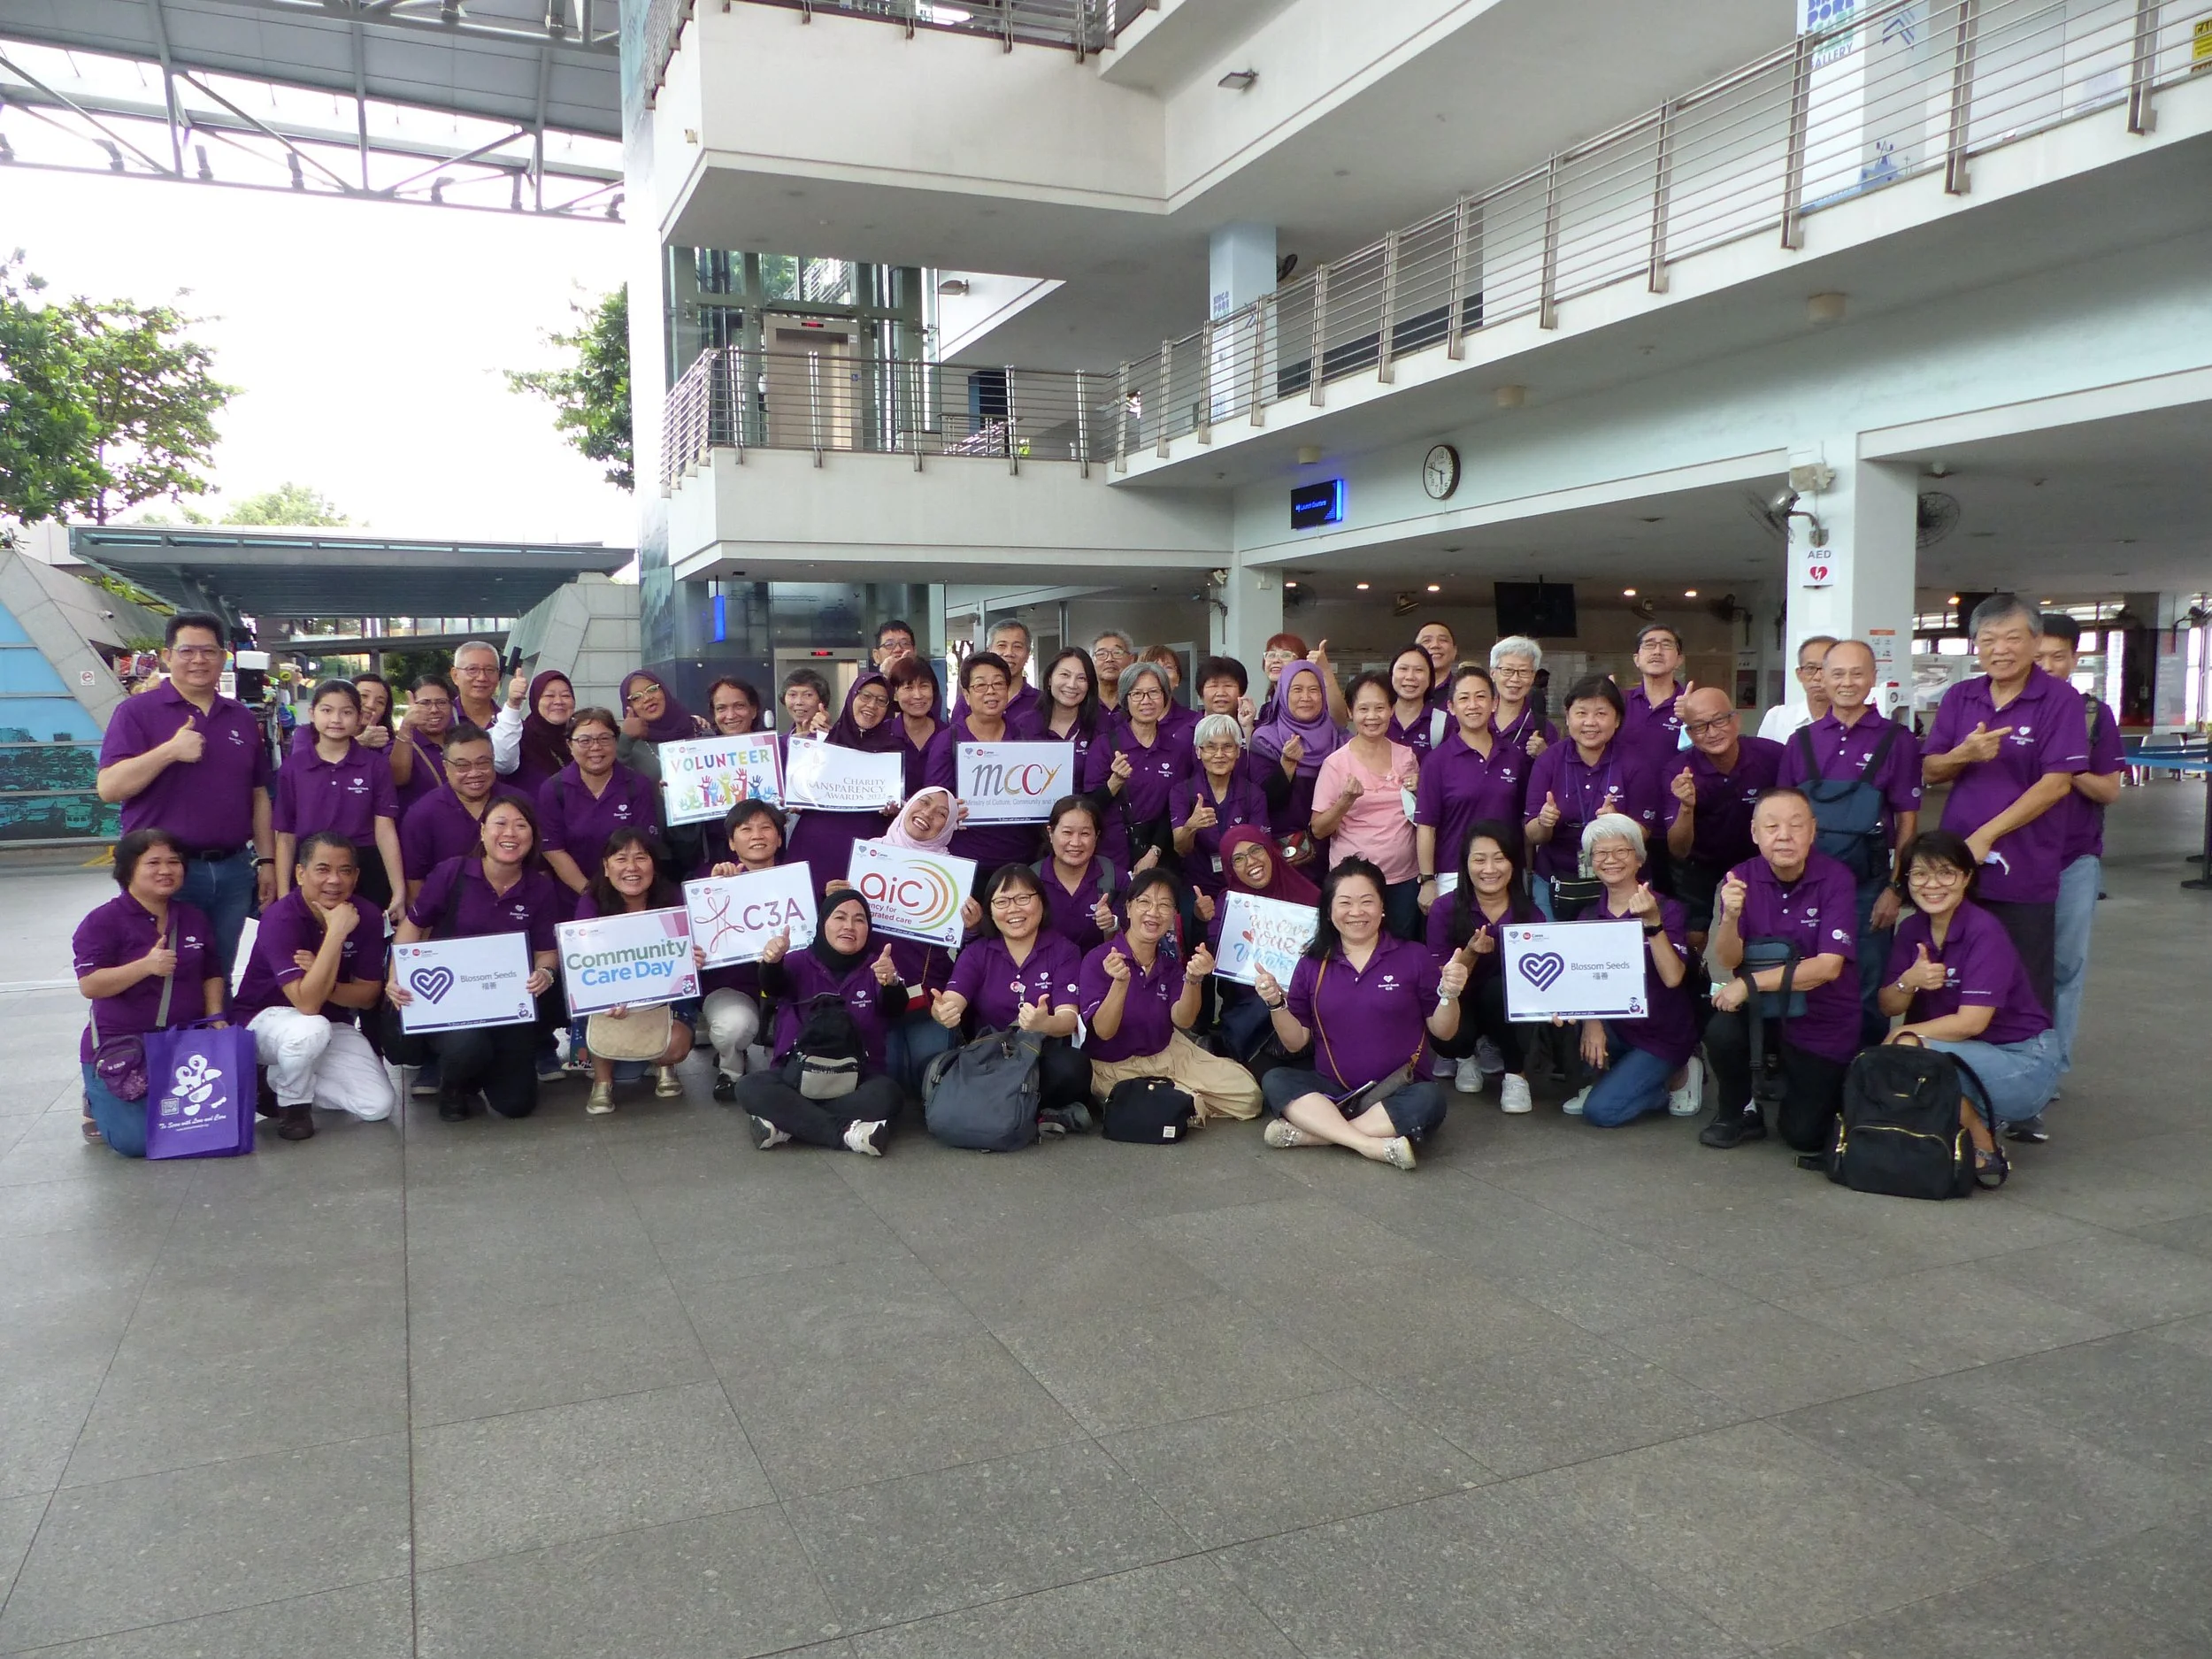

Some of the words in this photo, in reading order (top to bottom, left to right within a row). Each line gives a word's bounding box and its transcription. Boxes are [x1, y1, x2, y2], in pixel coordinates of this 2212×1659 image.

[671, 749, 770, 773] VOLUNTEER
[809, 780, 886, 794] ANSPARENCY
[843, 777, 886, 786] CHARITY
[826, 791, 864, 801] AWARDS
[860, 872, 923, 907] aic
[743, 897, 805, 930] C3A
[895, 916, 912, 925] care
[566, 939, 687, 970] Community
[1606, 961, 1630, 970] Seeds
[460, 973, 493, 983] Blossom
[494, 971, 518, 979] Seeds
[581, 966, 632, 986] Care
[634, 960, 674, 979] Day
